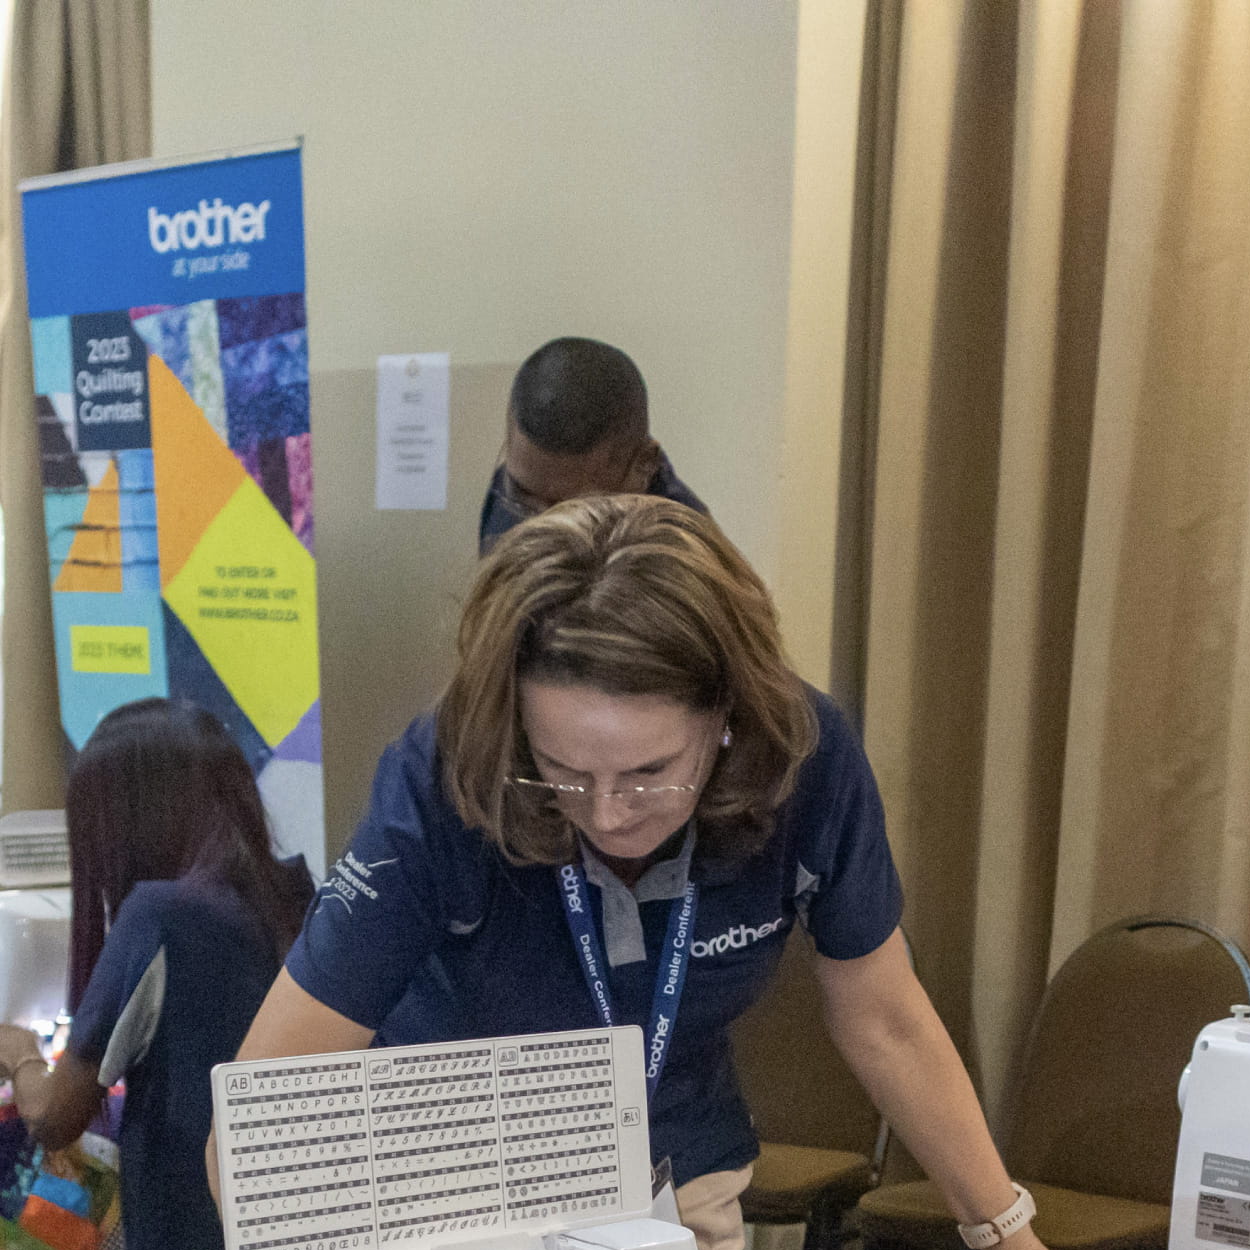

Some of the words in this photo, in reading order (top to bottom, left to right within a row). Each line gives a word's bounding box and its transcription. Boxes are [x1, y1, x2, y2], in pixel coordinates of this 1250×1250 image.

[148, 198, 271, 253] brother
[76, 366, 144, 398] Quilting
[79, 400, 144, 424] Contest
[335, 858, 378, 900] Conference
[345, 851, 373, 878] Dealer
[560, 864, 584, 914] other
[663, 950, 683, 995] Dealer
[673, 880, 696, 948] Conferenc
[690, 917, 783, 958] brother
[579, 933, 599, 978] Dealer
[594, 979, 612, 1027] Confer
[646, 1013, 671, 1079] brother
[229, 1077, 249, 1091] AB
